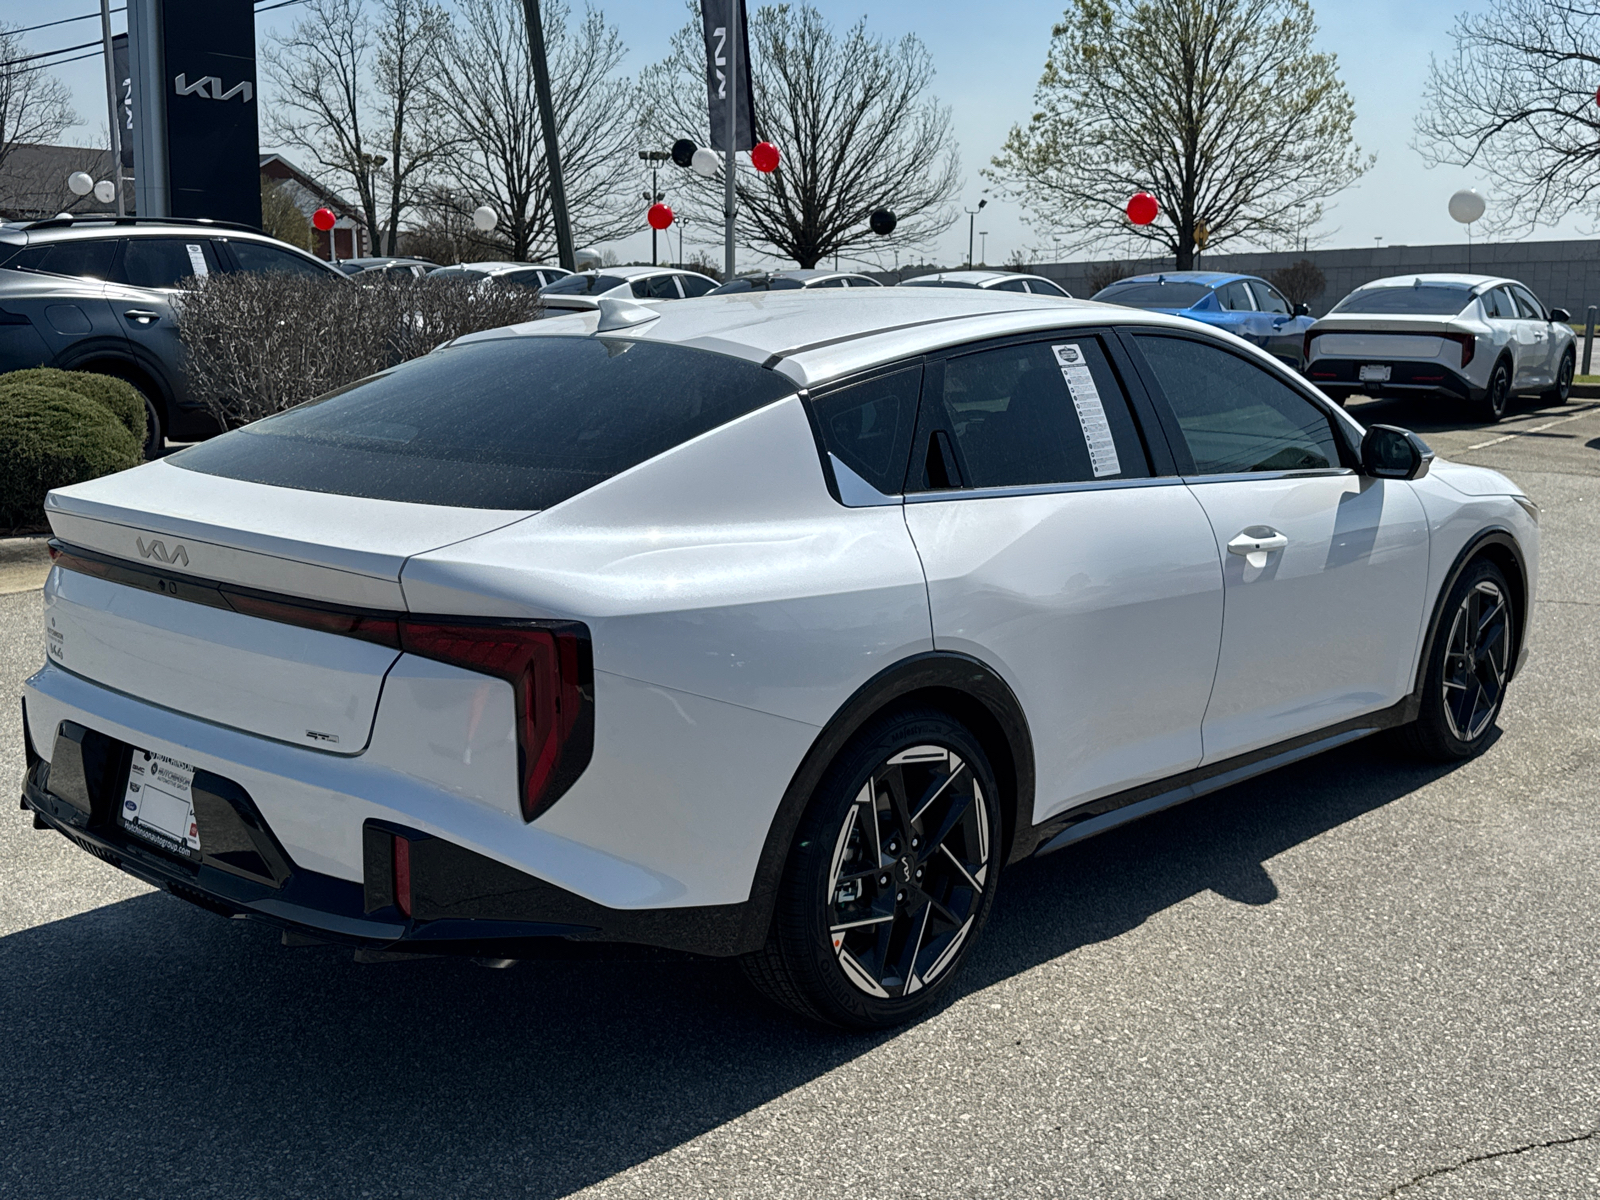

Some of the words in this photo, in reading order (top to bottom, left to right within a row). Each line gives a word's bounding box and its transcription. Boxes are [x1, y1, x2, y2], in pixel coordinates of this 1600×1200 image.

[174, 72, 253, 103] KIA
[135, 536, 190, 567] KIA
[158, 767, 192, 787] HUTCHINSON
[820, 958, 859, 1012] KUMHO
